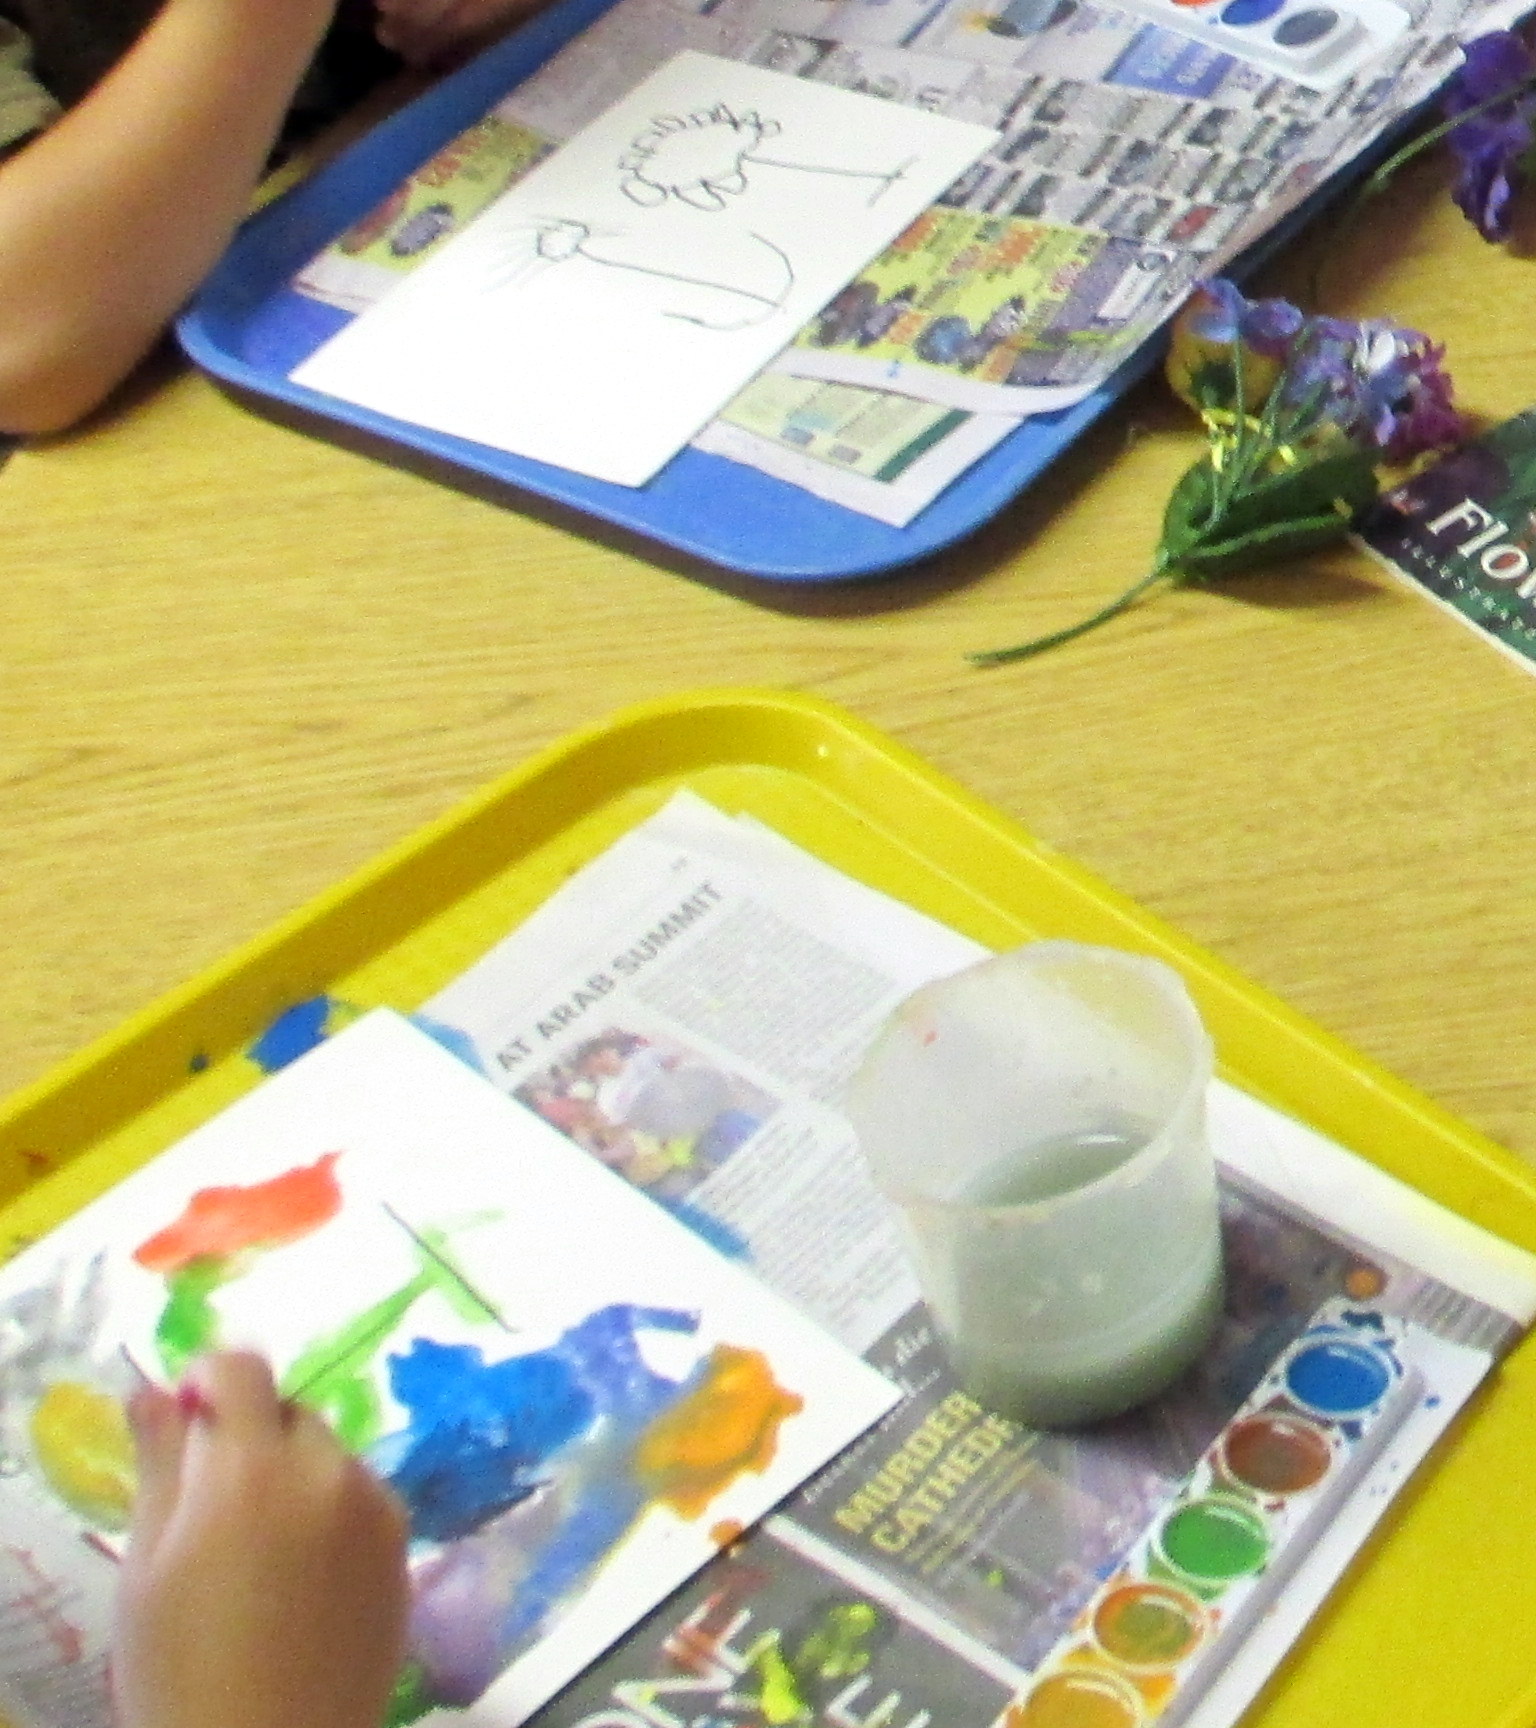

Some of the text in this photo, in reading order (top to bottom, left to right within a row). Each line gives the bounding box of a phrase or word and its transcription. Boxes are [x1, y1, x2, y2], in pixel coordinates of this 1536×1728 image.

[496, 1036, 533, 1072] AT
[535, 973, 615, 1040] ARAB
[612, 880, 722, 976] SUMMIT
[833, 1390, 984, 1535] MURDER
